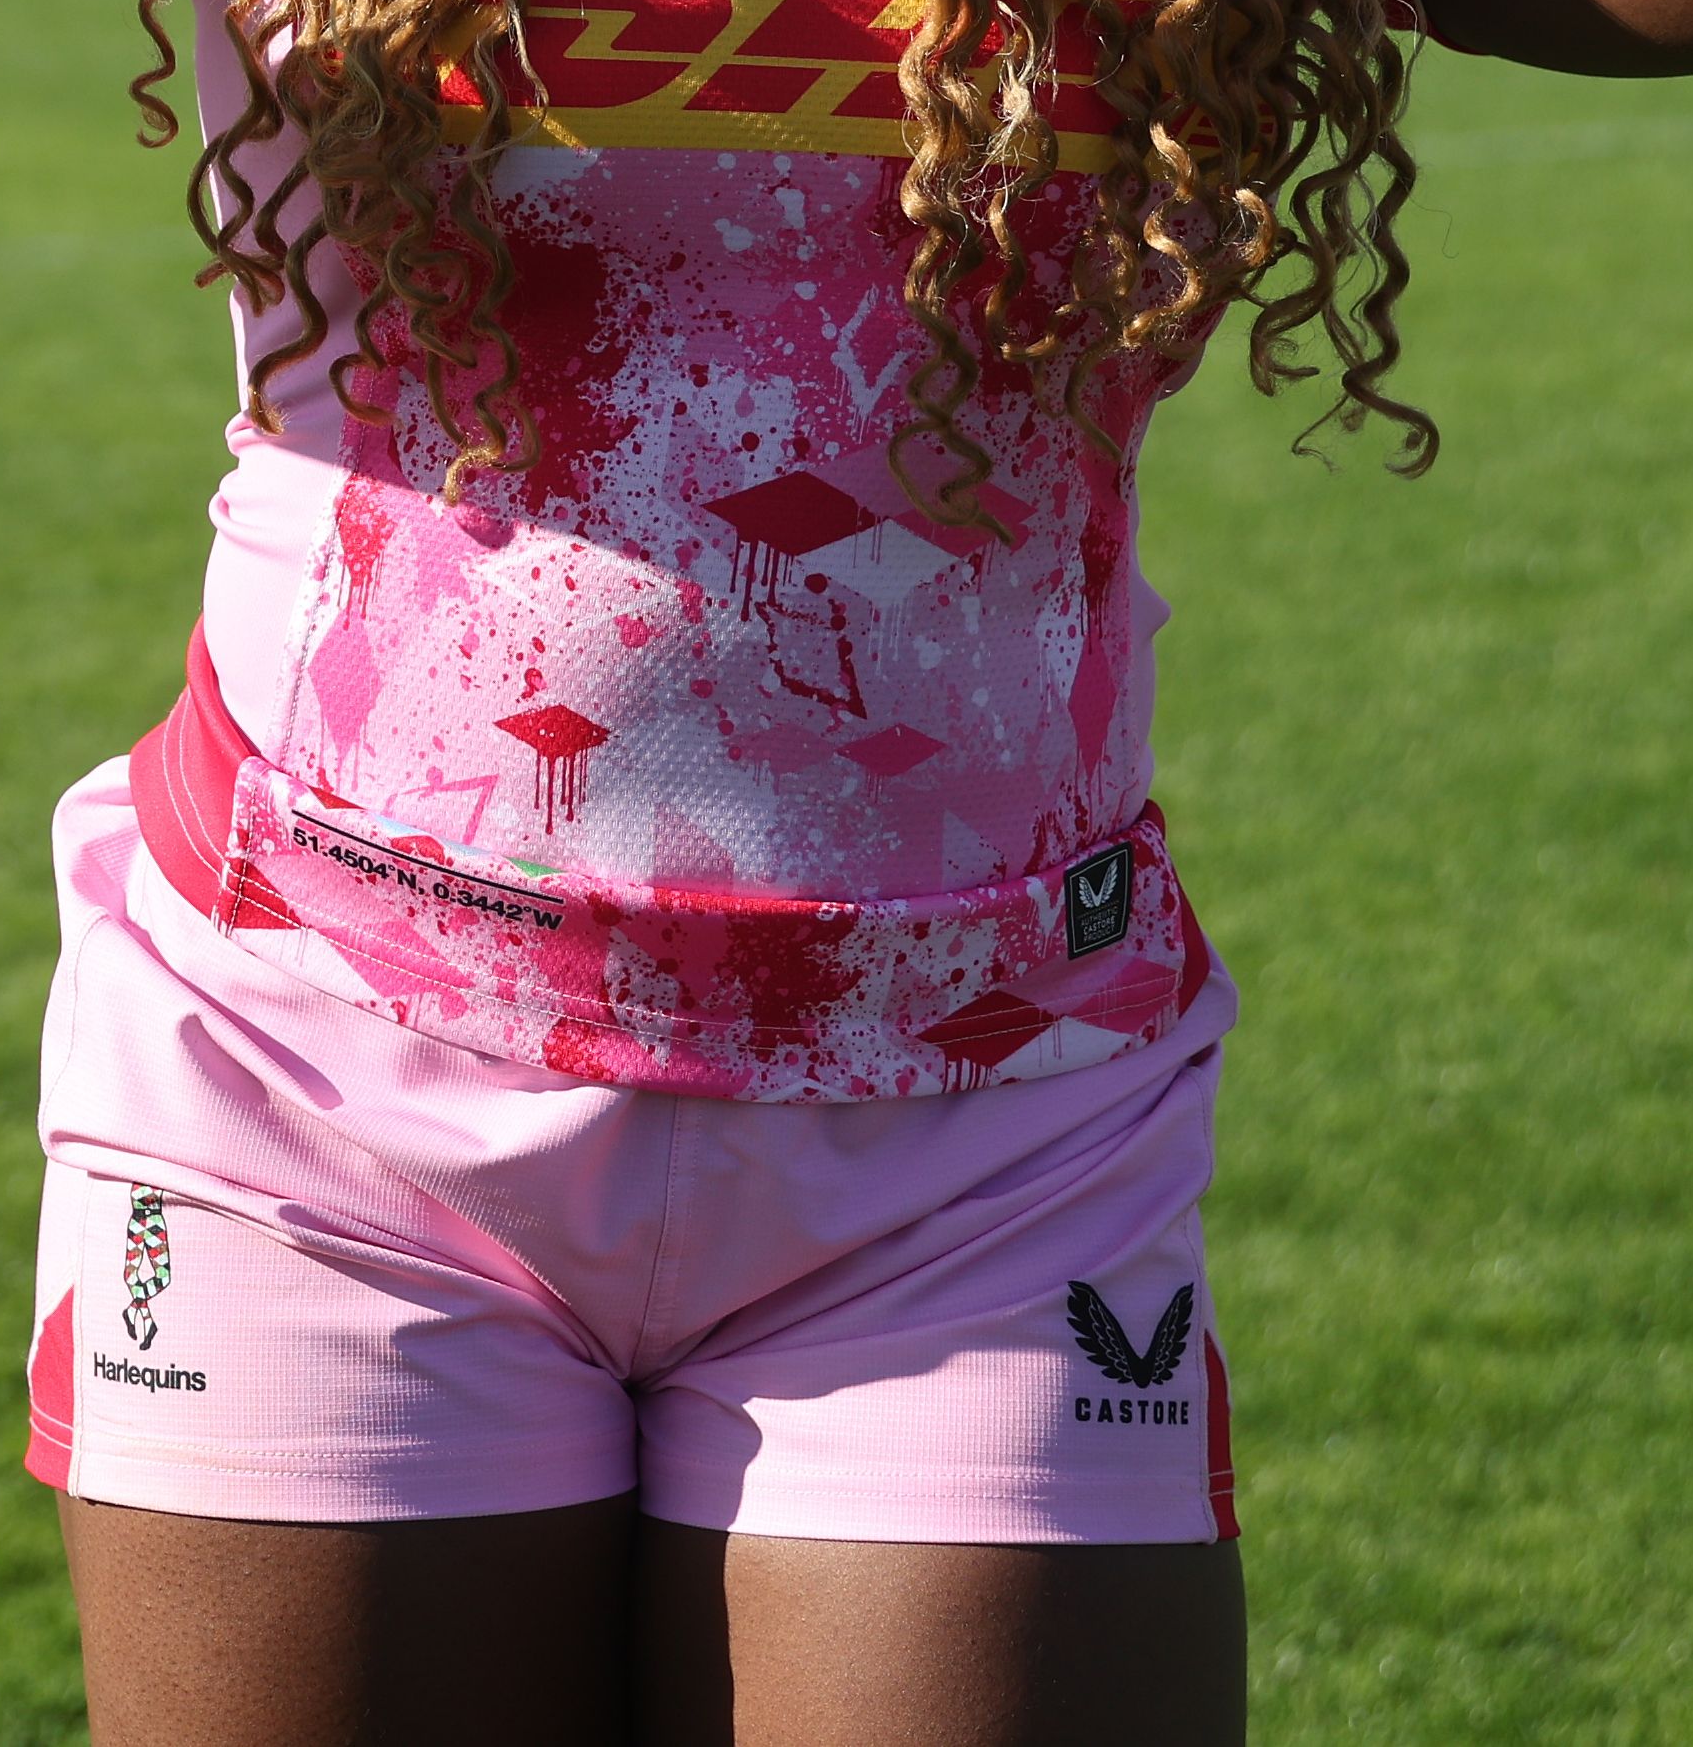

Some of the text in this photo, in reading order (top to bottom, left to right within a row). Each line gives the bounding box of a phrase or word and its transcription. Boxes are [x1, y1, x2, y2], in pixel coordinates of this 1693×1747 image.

[292, 827, 563, 930] 51.4504°N, 0.3442°W
[1083, 915, 1116, 937] CASTORE
[93, 1352, 207, 1393] Harlequins
[1074, 1397, 1189, 1425] CASTORE
